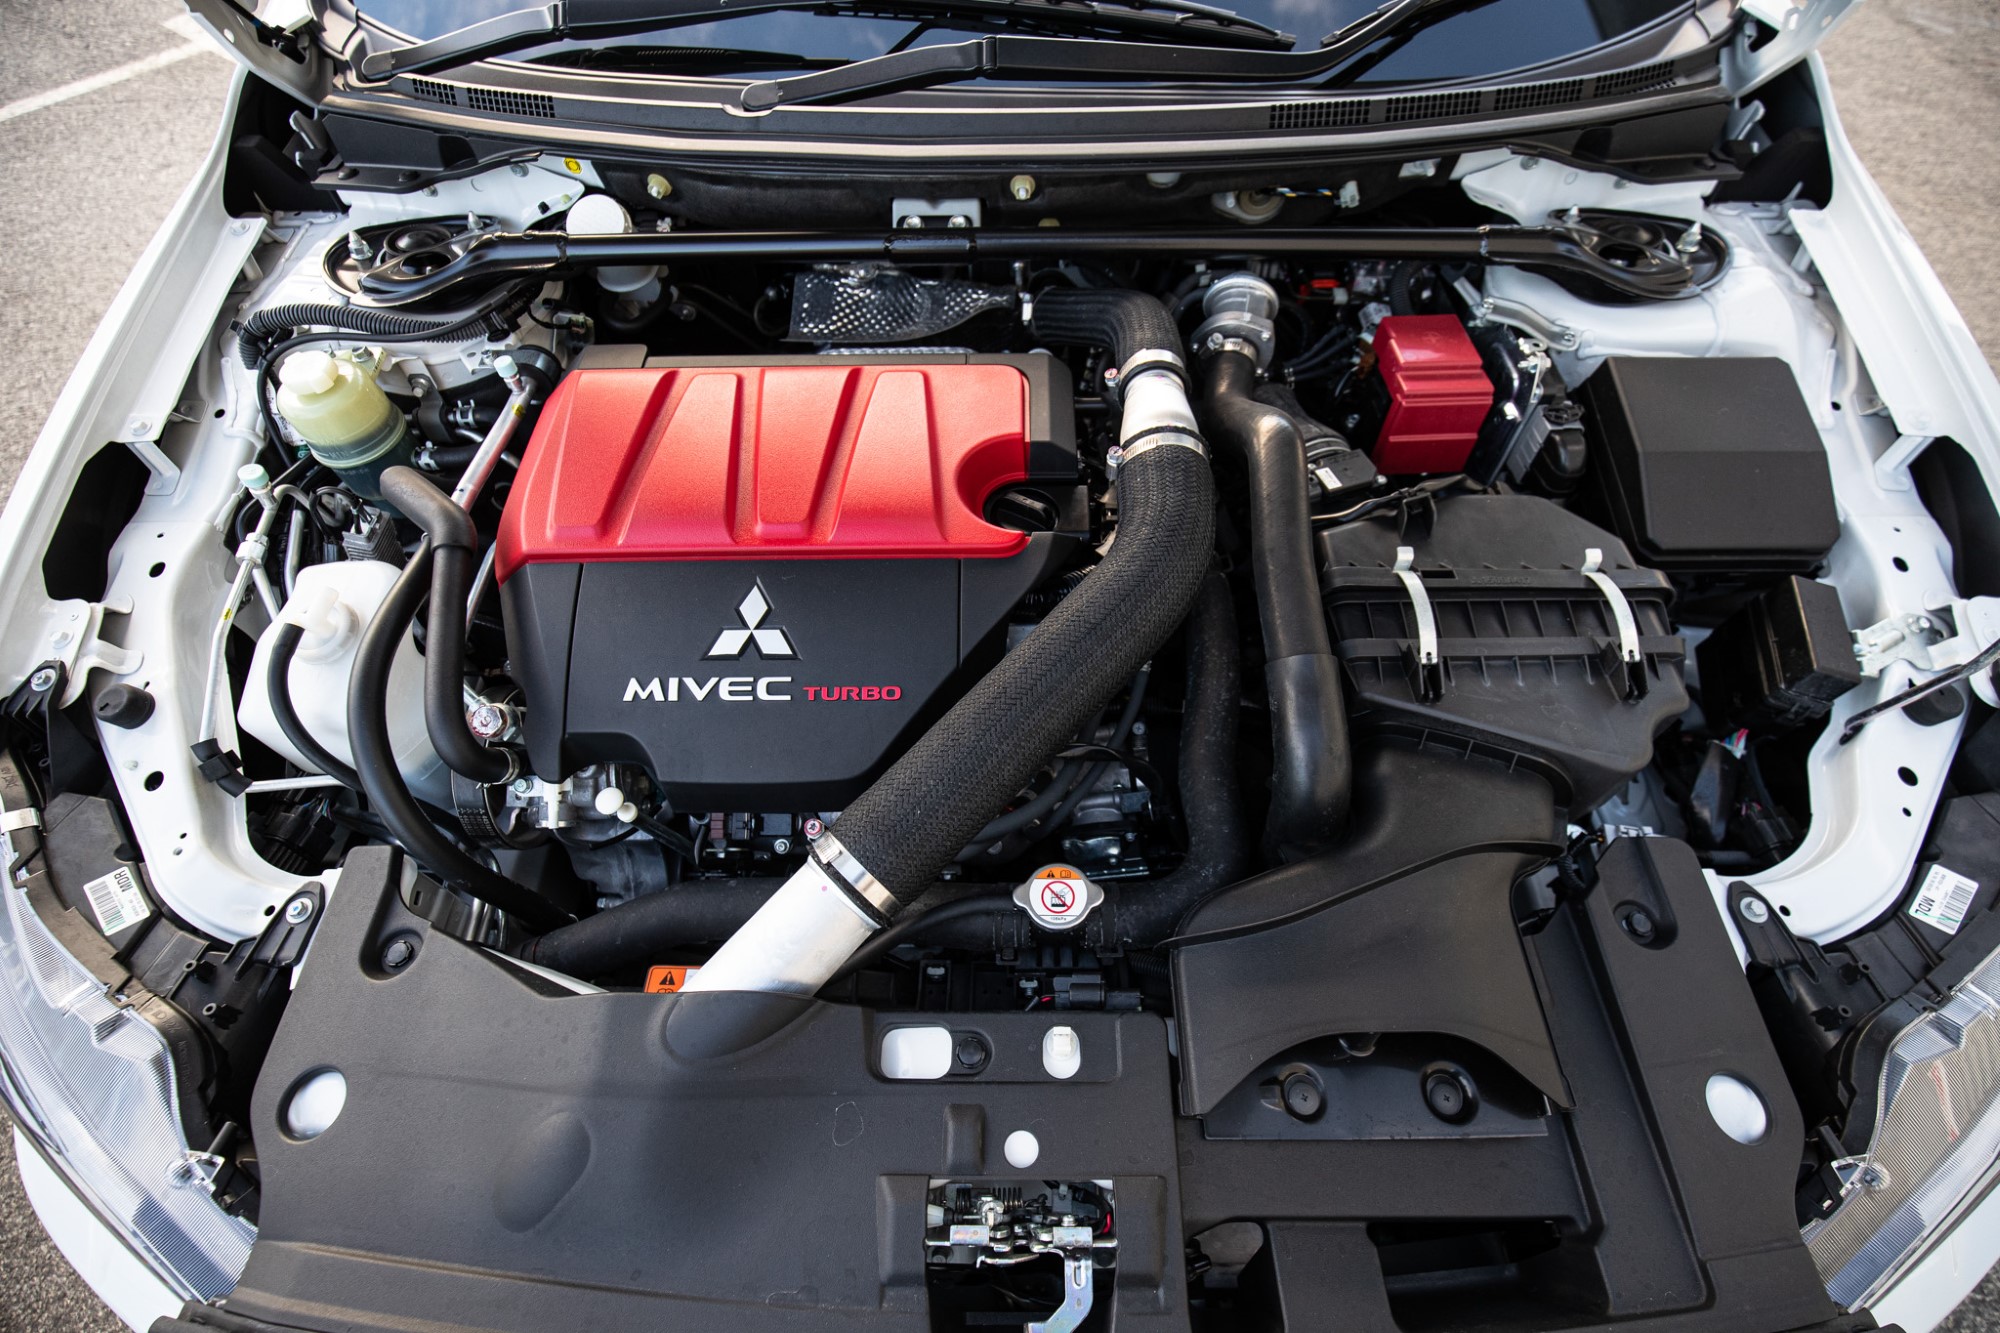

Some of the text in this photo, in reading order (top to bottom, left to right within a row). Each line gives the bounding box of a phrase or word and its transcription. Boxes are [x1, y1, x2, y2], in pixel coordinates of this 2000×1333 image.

[622, 676, 902, 702] MIVEC TURBO
[113, 869, 134, 893] MDR
[1914, 894, 1936, 917] MDL
